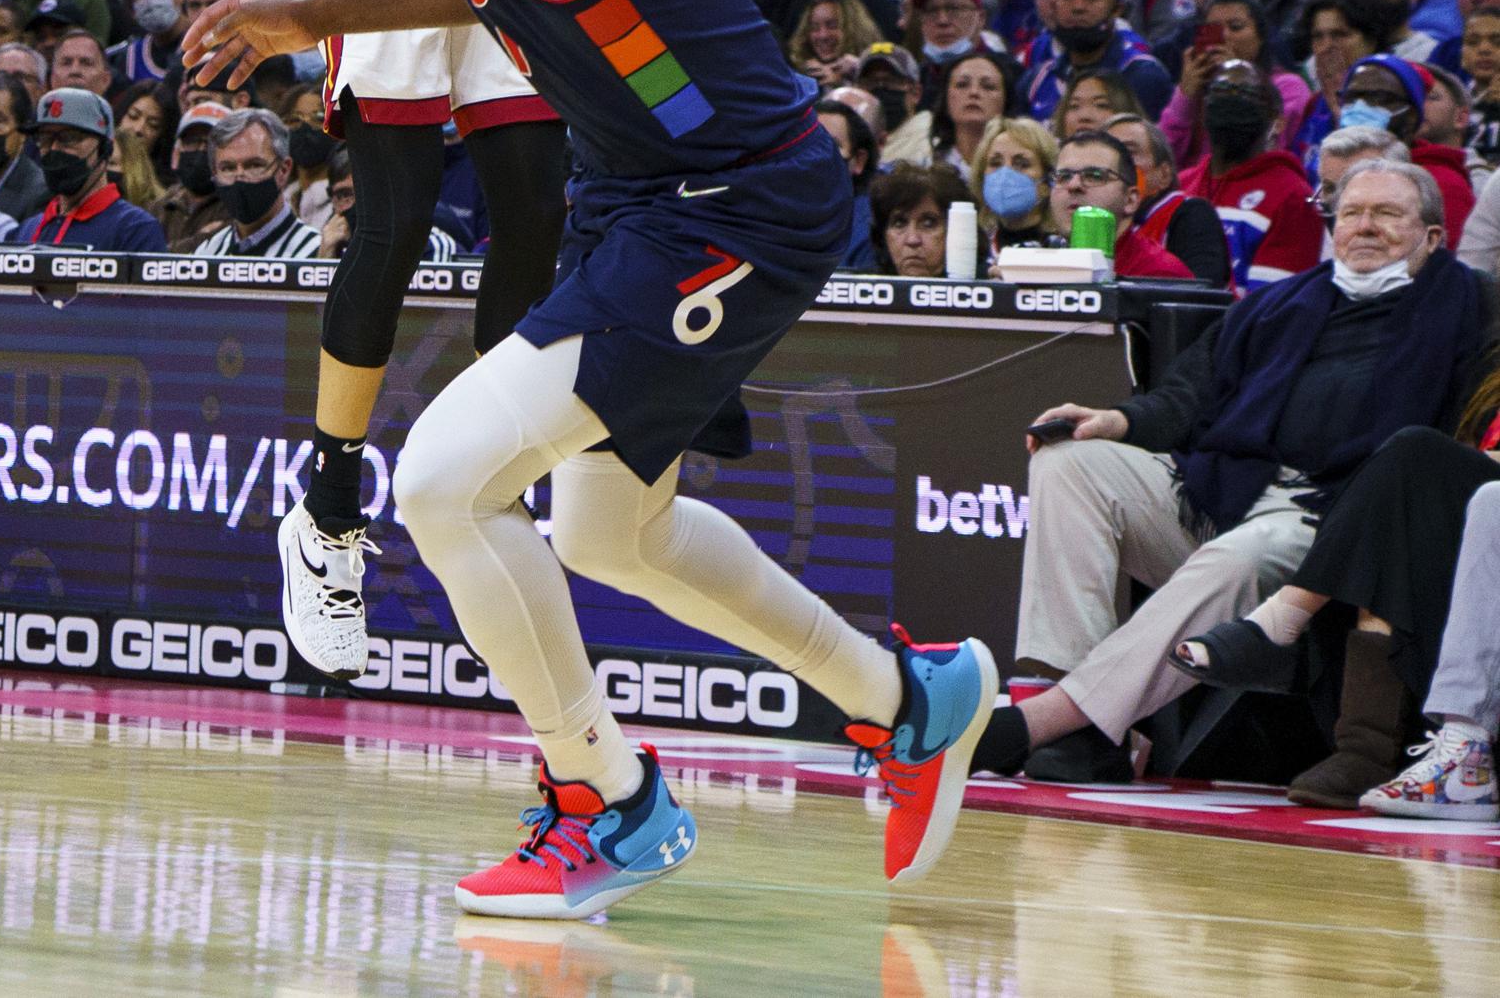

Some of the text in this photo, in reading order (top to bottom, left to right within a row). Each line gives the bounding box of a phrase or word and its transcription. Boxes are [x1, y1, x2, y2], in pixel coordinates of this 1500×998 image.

[51, 256, 117, 279] GEICO
[142, 259, 207, 282] GEICO
[218, 260, 285, 284] GEICO
[910, 284, 993, 309] GEICO
[1016, 289, 1100, 313] GEICO
[110, 617, 288, 681] GEICO
[597, 658, 799, 728] GEICO
